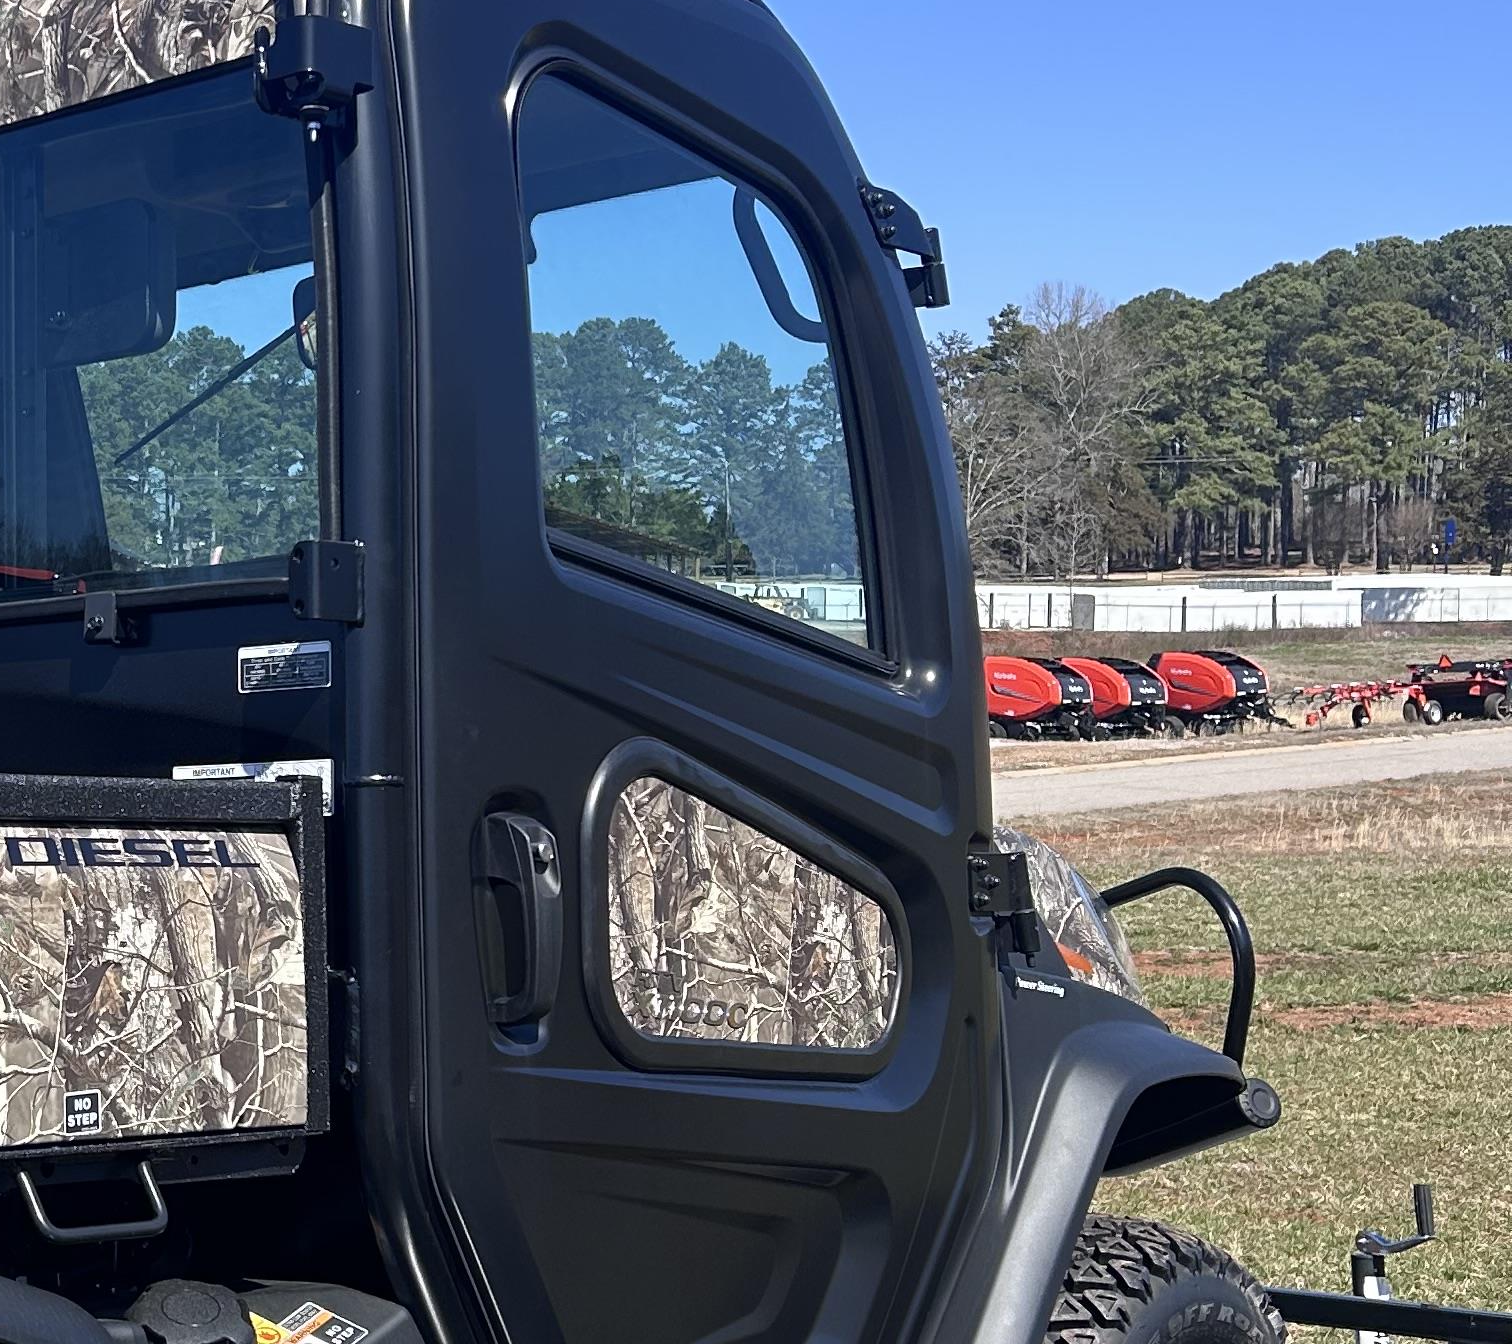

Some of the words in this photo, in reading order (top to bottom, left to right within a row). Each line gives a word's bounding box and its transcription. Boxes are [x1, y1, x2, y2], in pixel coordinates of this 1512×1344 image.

[193, 767, 235, 776] IMPORTANT
[4, 837, 260, 867] DIESEL
[74, 1097, 91, 1111] NO
[68, 1112, 97, 1127] STEP
[1168, 1302, 1215, 1338] OFF
[325, 1324, 342, 1337] NO
[331, 1326, 355, 1344] STEP
